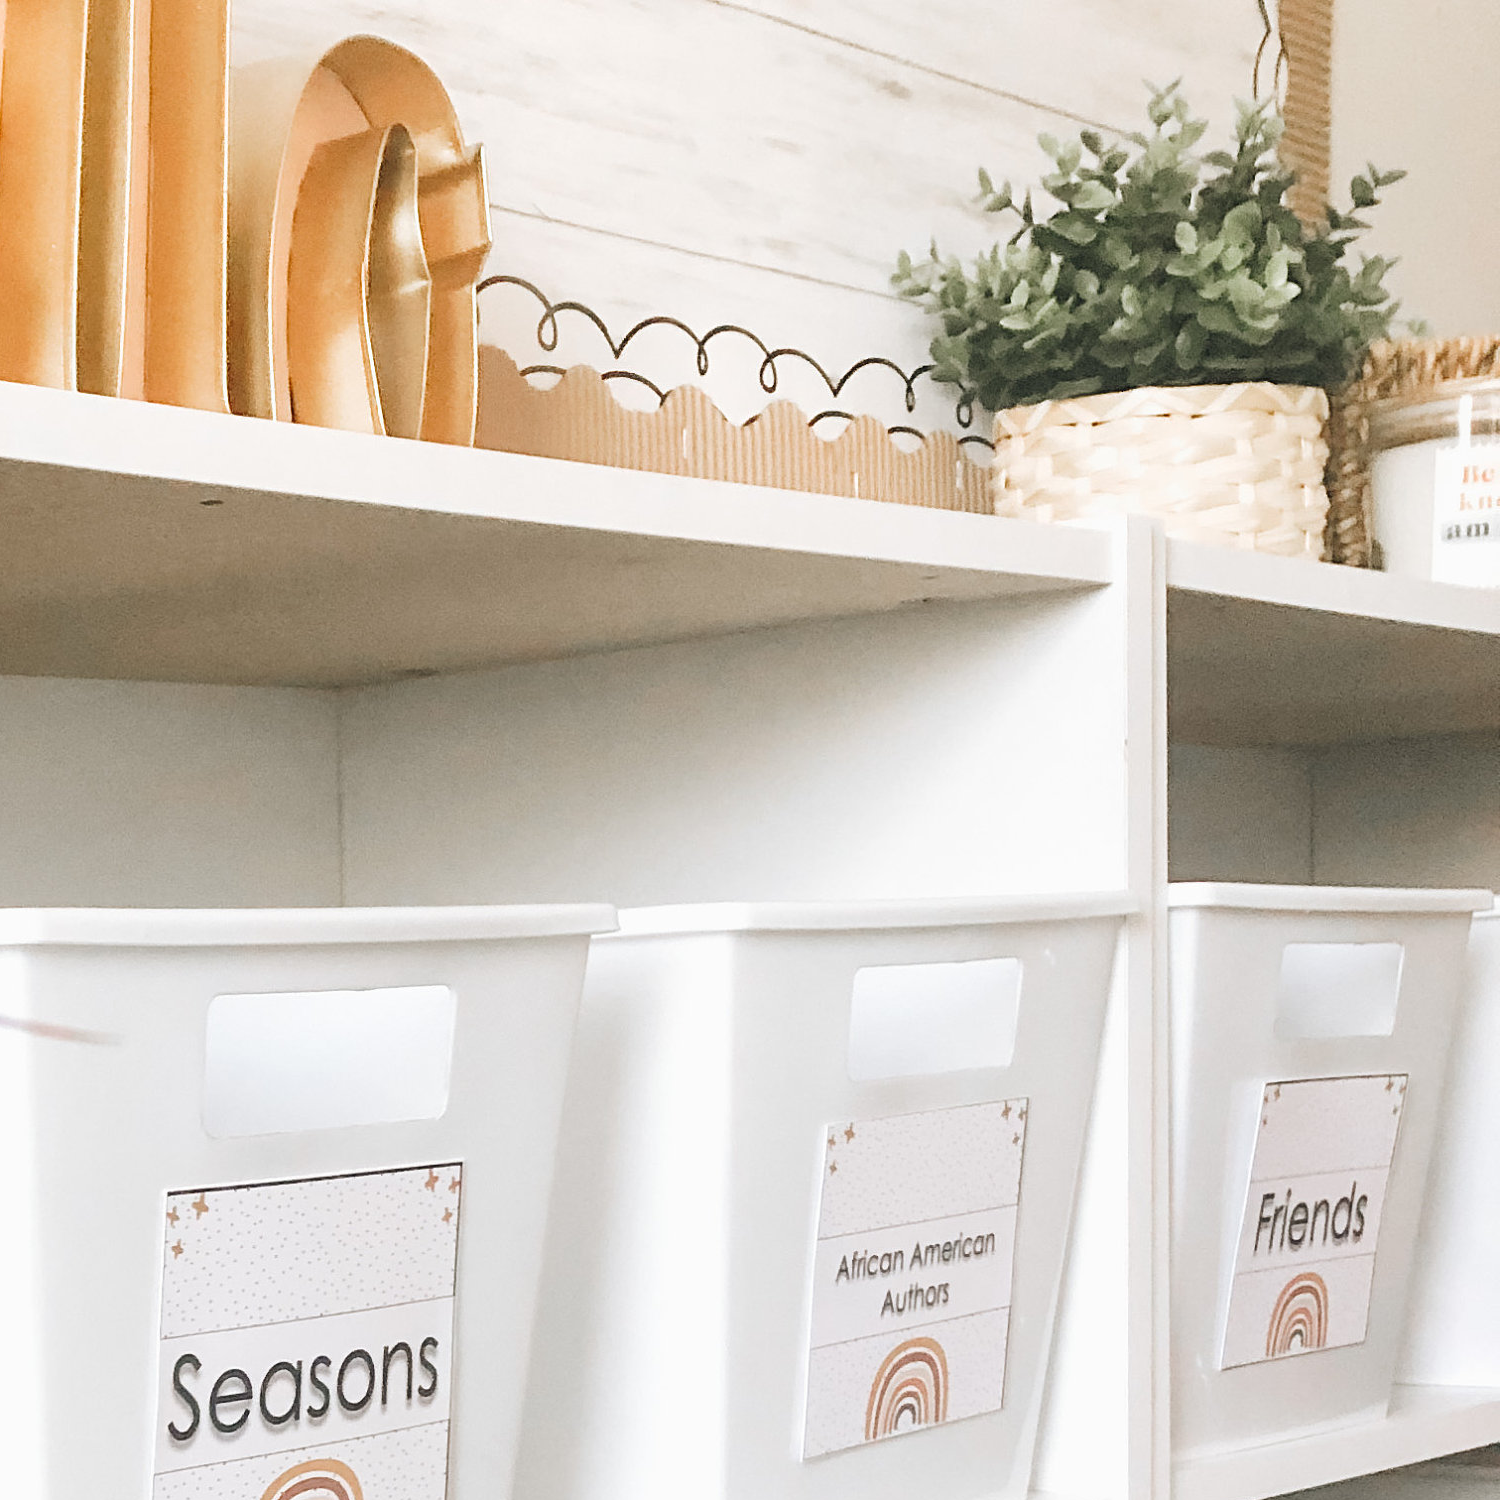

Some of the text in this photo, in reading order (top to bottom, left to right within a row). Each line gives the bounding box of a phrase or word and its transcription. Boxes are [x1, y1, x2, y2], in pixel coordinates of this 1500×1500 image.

[1459, 491, 1500, 512] kn
[1253, 1180, 1368, 1252] Friends
[835, 1231, 995, 1283] African American
[881, 1281, 950, 1318] Authors
[167, 1336, 440, 1442] Seasons
